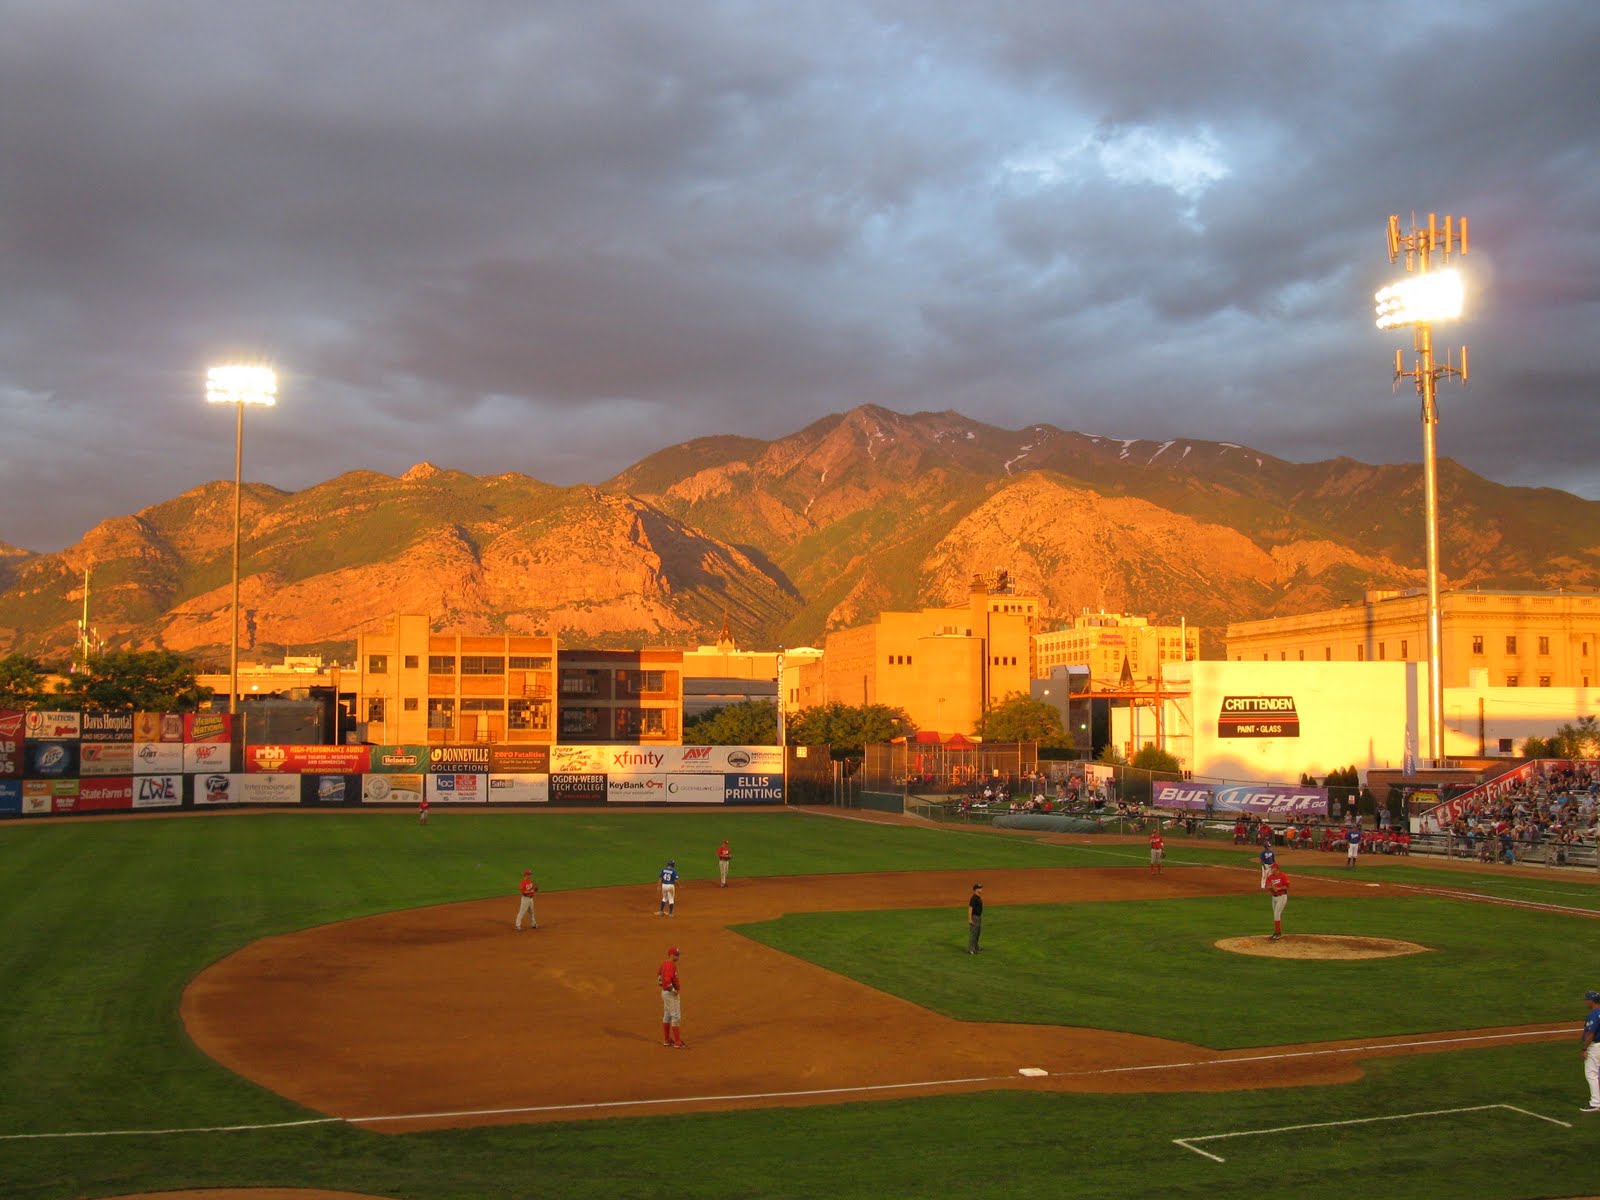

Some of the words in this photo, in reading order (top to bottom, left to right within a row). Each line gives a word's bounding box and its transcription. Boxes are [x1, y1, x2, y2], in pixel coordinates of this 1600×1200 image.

[1225, 698, 1293, 710] CRITTENDEN
[84, 713, 103, 729] Davis
[103, 713, 132, 731] Hospital
[195, 716, 222, 726] HEBREW
[193, 723, 225, 735] NATIONAL
[1237, 725, 1255, 733] PAINT
[1260, 725, 1282, 733] GLASS
[255, 746, 285, 759] rbh
[442, 748, 489, 762] BONNEVILLE
[613, 751, 664, 768] xfinity
[430, 764, 489, 772] COLLECTIONS
[552, 775, 604, 784] OGDEN-WEBER
[738, 777, 769, 787] ELLIS
[81, 788, 101, 799] State
[102, 788, 123, 798] Farm
[726, 789, 782, 799] PRINTING
[1158, 788, 1208, 802] BUD
[1226, 791, 1320, 807] LIGHT
